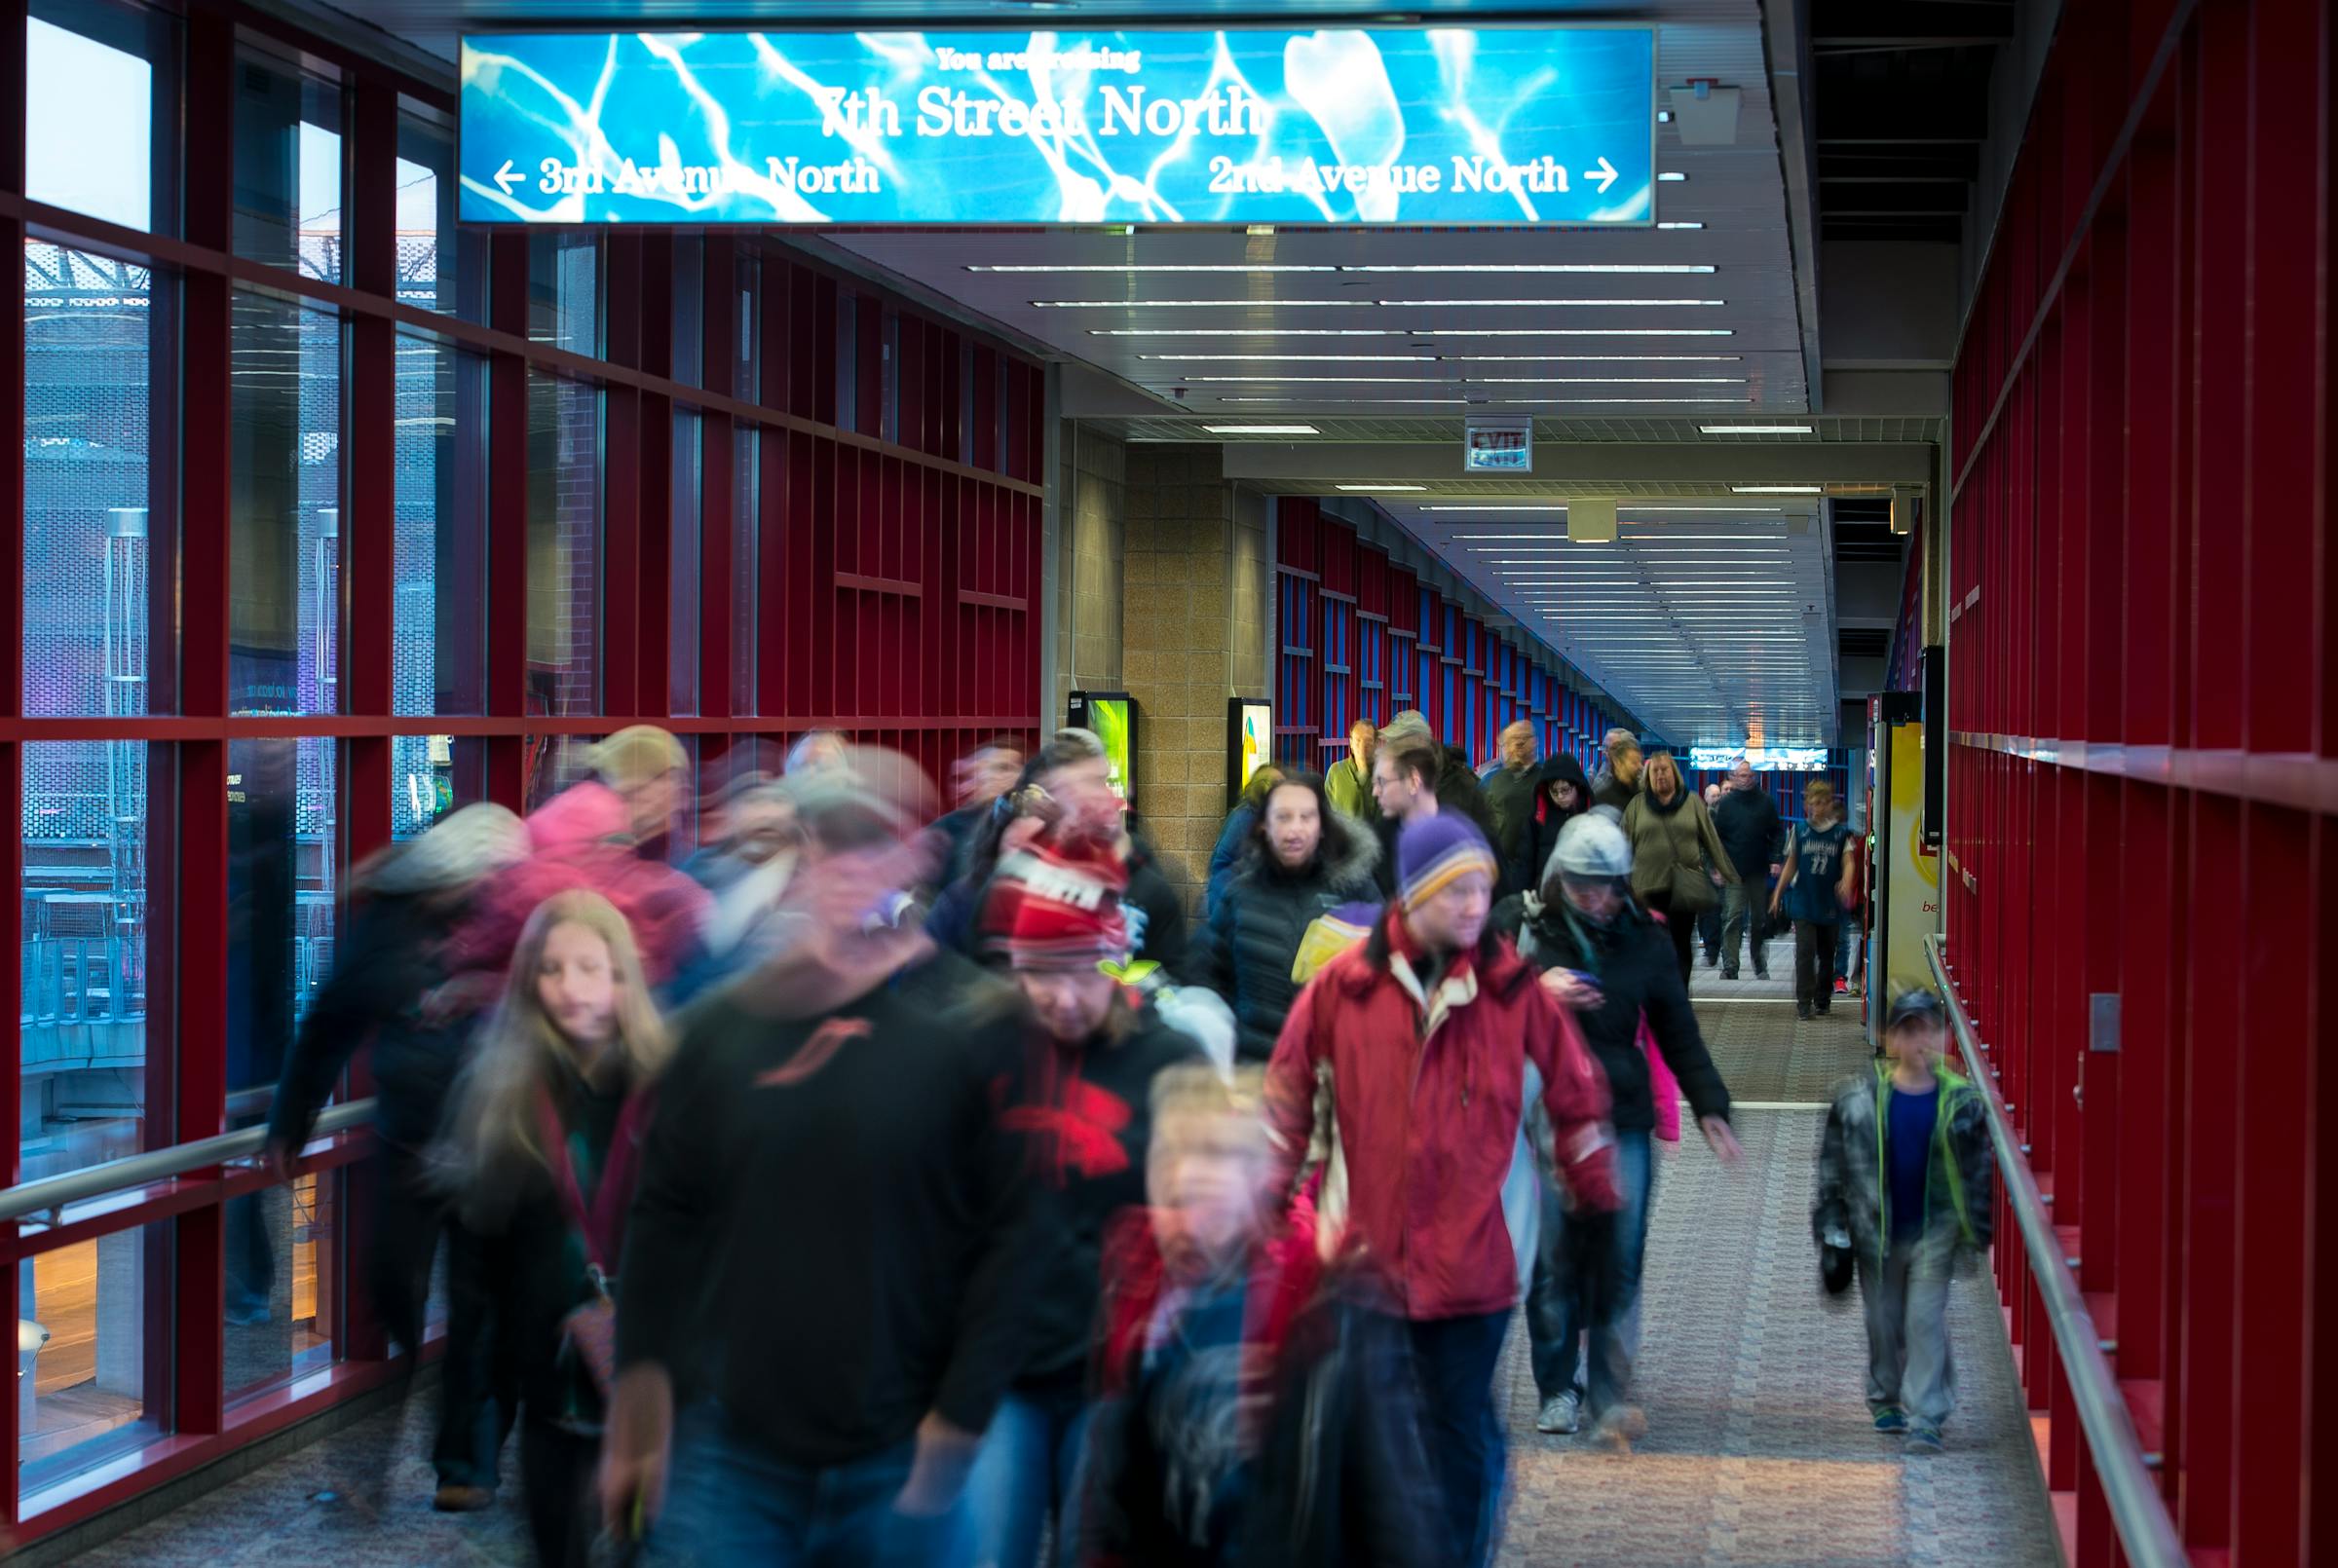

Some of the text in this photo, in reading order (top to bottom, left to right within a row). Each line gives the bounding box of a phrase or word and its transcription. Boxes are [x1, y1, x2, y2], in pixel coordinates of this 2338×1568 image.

[935, 46, 1142, 74] You are rosing
[820, 85, 1264, 137] 7th Street North
[539, 157, 881, 194] 3rd Avenu North
[1208, 156, 1283, 194] 2nd
[1450, 156, 1570, 194] North
